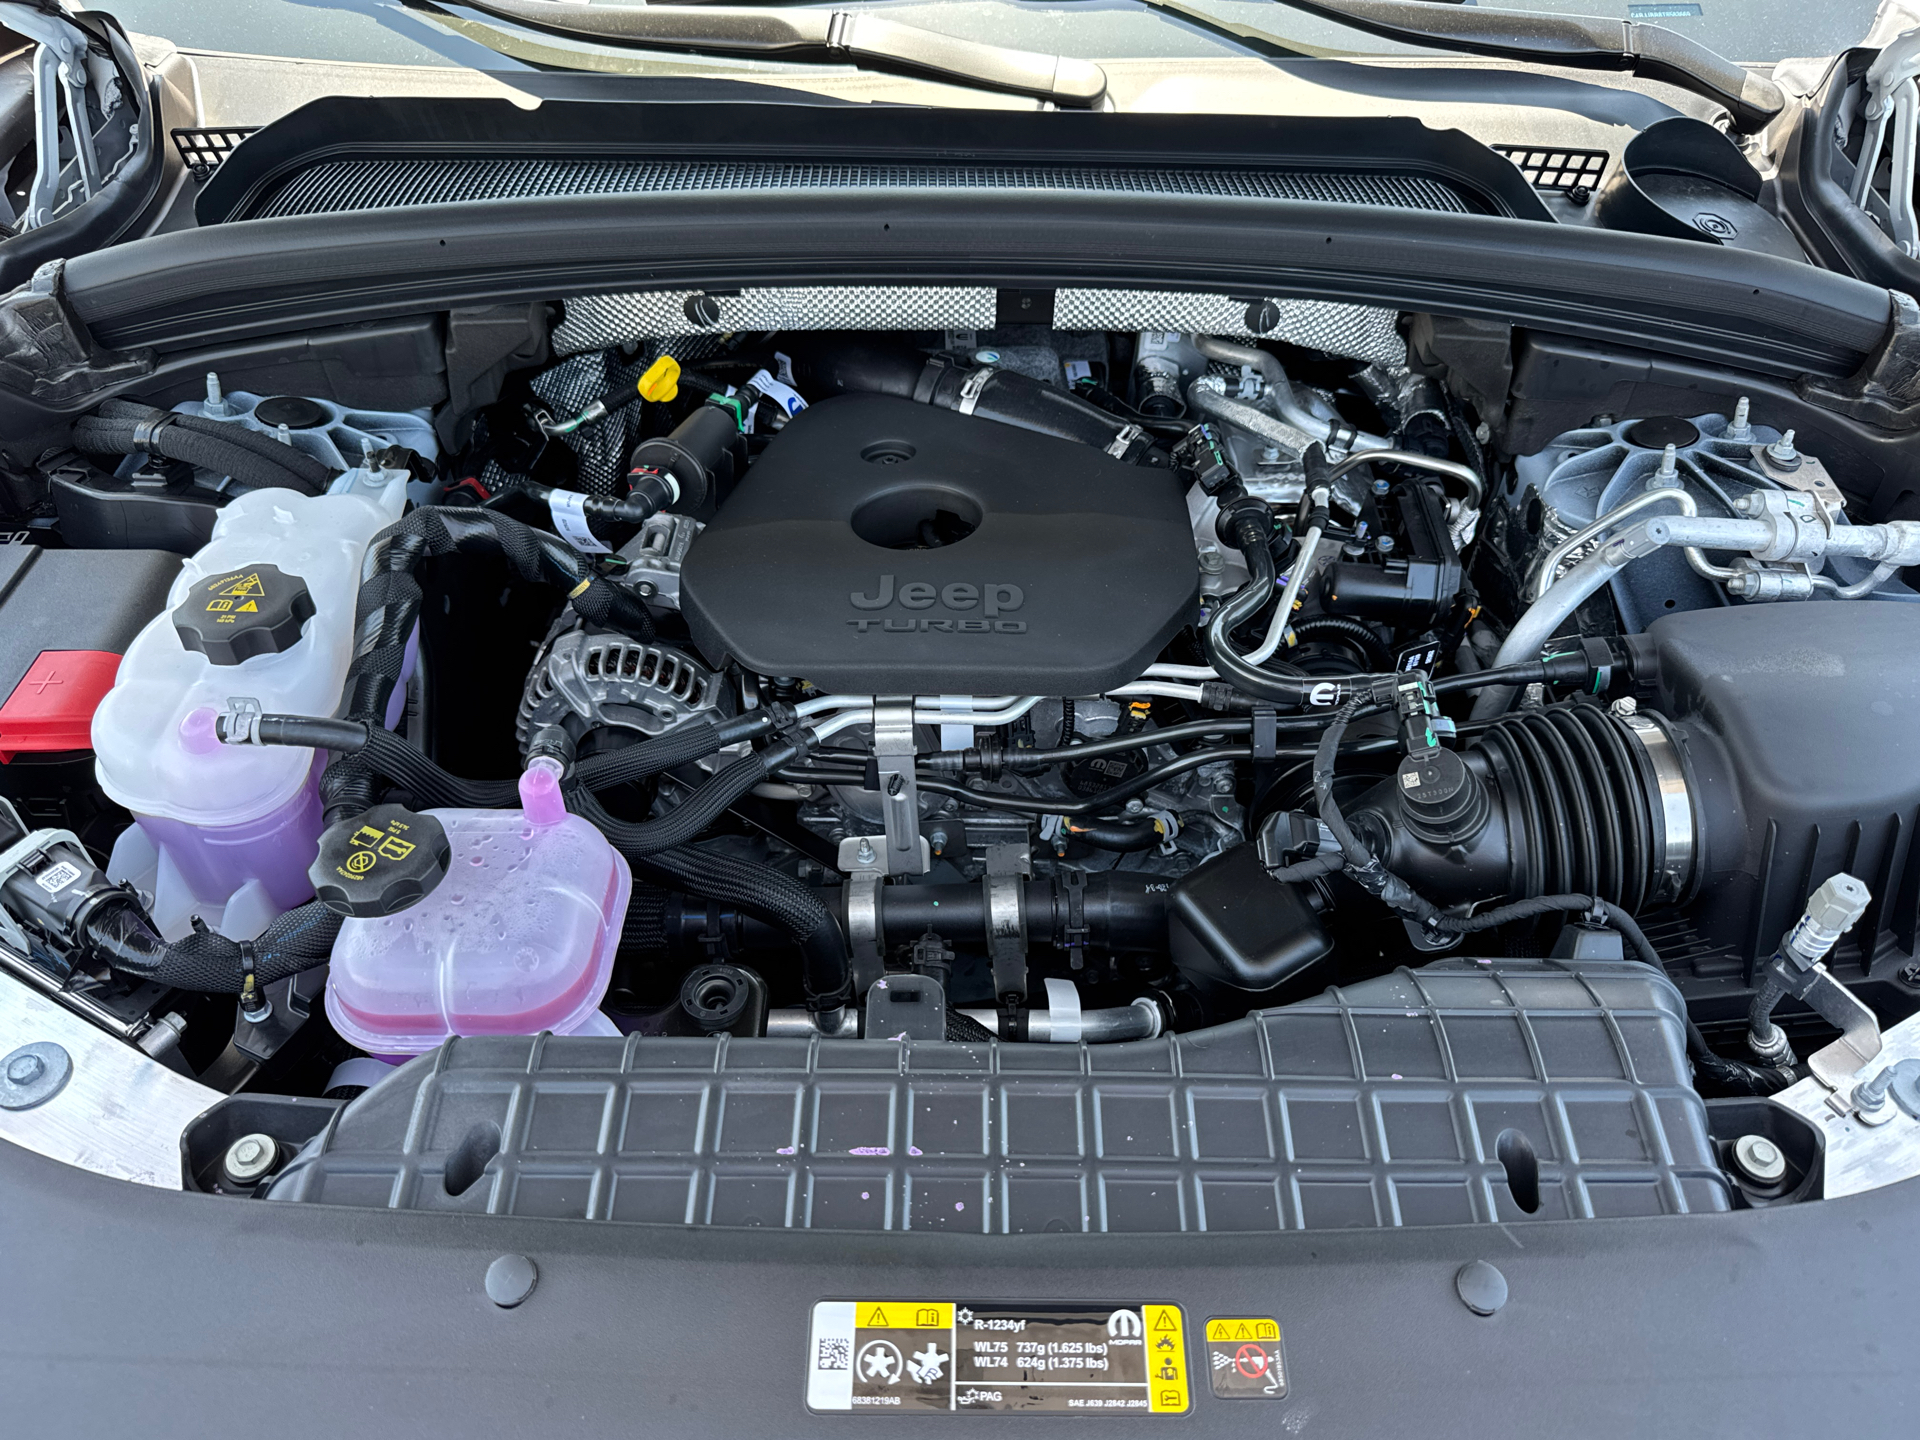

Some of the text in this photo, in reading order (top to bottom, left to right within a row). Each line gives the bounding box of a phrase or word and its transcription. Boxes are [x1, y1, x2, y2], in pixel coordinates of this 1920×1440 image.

[850, 574, 1025, 618] Jeep
[846, 619, 1028, 634] TURBO
[974, 1319, 1026, 1333] R-1234yf
[973, 1341, 1108, 1356] WL75 737g (1.625 lbs)
[973, 1356, 1109, 1371] WL74 624g (1.375 lbs)
[852, 1396, 901, 1405] 68381219AB
[980, 1391, 1003, 1402] PAG
[1068, 1399, 1084, 1407] SAE
